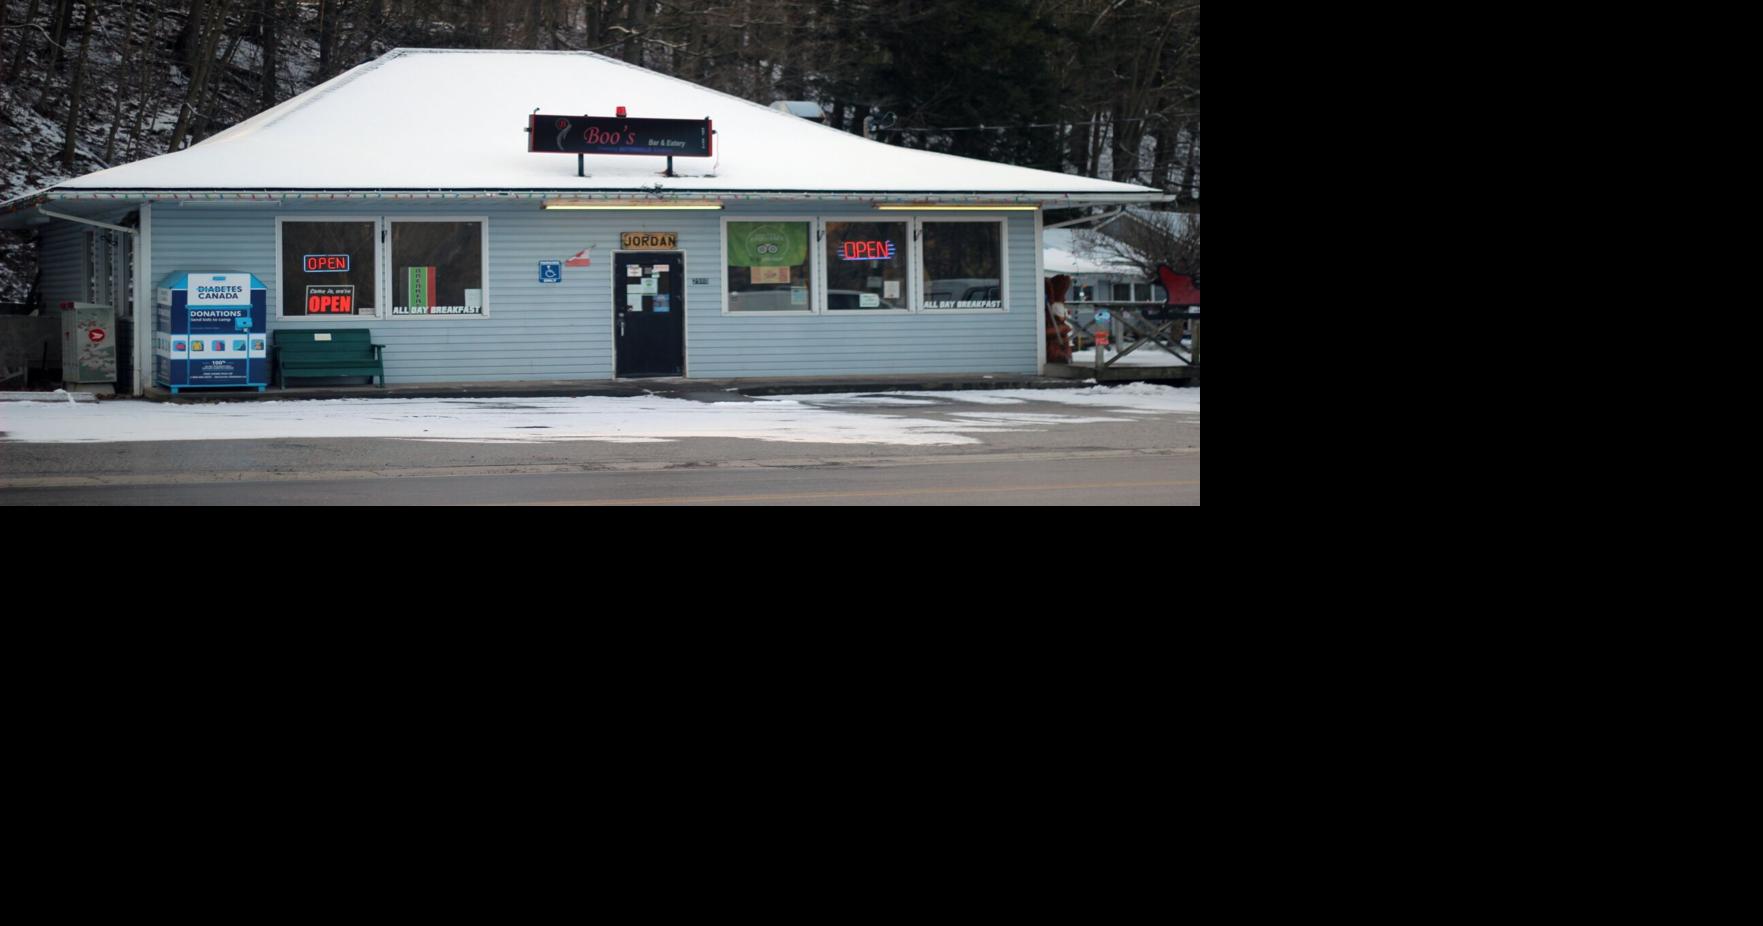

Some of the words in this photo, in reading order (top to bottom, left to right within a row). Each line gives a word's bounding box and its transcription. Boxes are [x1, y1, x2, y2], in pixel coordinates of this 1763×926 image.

[584, 125, 636, 145] Boo's
[648, 138, 659, 146] Bar
[666, 139, 686, 148] Eatery
[624, 236, 677, 247] JORDAN
[844, 240, 889, 258] OPEN
[308, 257, 346, 270] OPEN
[309, 295, 351, 312] OPEN
[924, 300, 938, 308] ALL
[940, 300, 956, 308] DAY
[957, 300, 1002, 308] BREAKFAST
[393, 306, 409, 314] ALL
[411, 306, 429, 314] DAY
[430, 306, 481, 314] BREAKFAST
